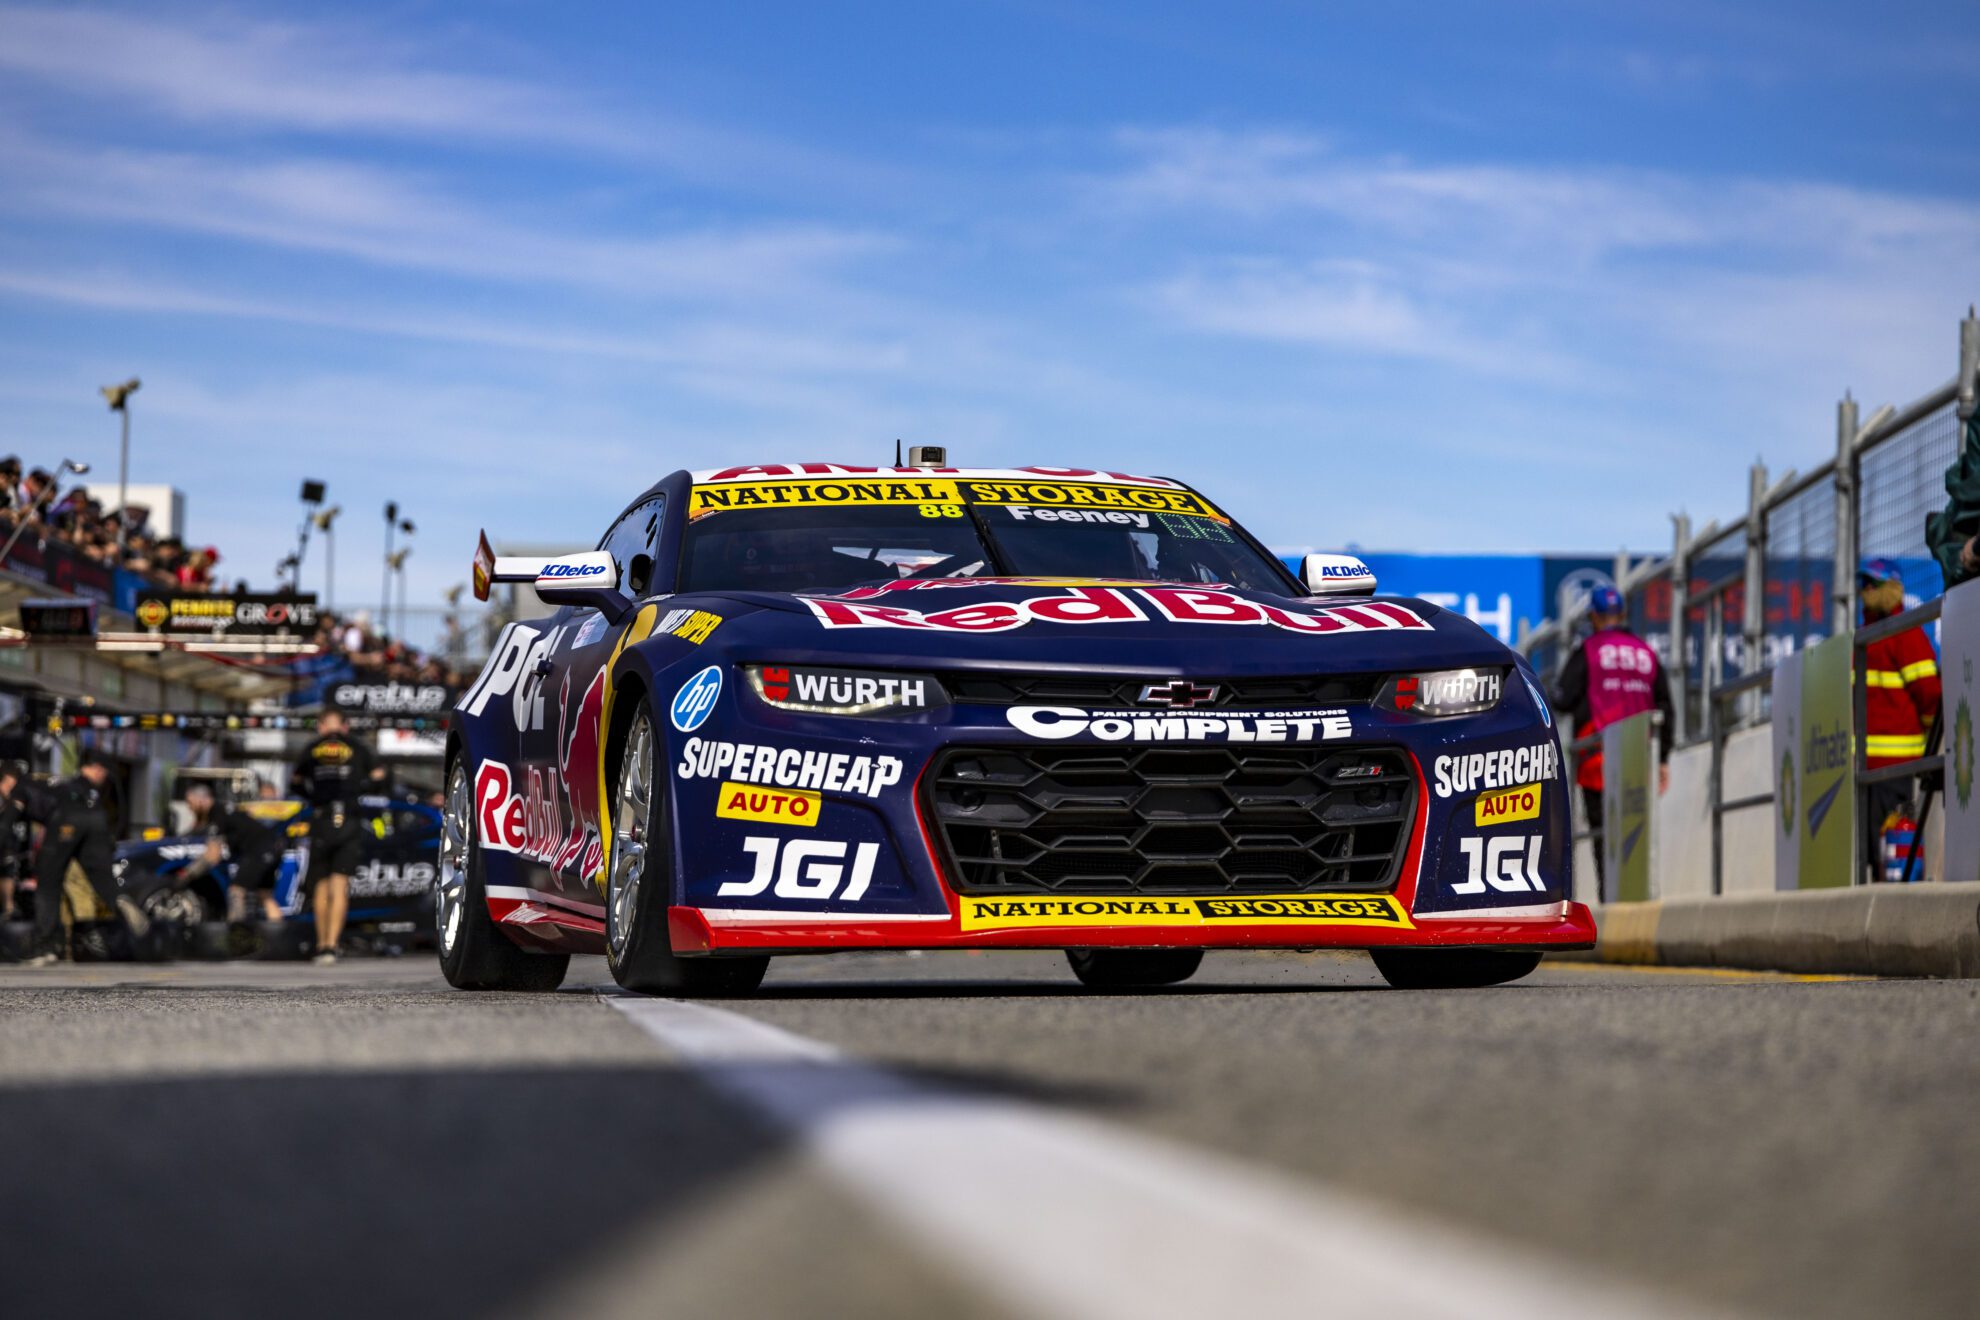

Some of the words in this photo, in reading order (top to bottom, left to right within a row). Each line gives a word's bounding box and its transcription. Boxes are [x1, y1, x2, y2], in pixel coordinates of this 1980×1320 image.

[695, 483, 949, 509] NATIONAL
[978, 483, 1198, 512] STORAGE
[919, 504, 964, 518] 88
[1006, 505, 1150, 528] Feeney
[540, 564, 607, 577] ACDelco
[1322, 565, 1372, 577] ACDelc
[237, 602, 316, 625] GROVE
[798, 588, 1149, 631] Red
[1146, 589, 1435, 634] Bull
[1598, 644, 1652, 675] 255
[677, 668, 718, 730] hp
[795, 674, 925, 707] WÜRTH
[1006, 706, 1352, 742] COMPLETE
[1264, 709, 1348, 718] SOLUTIONS
[678, 737, 903, 798] SUPERCHEAP
[475, 758, 535, 855] Red
[728, 792, 809, 817] AUTO
[1482, 792, 1534, 817] AUTO
[717, 836, 879, 901] JGI
[1451, 835, 1547, 895] JGI
[973, 901, 1191, 919] NATIONAL
[1212, 899, 1390, 918] STORAGE
